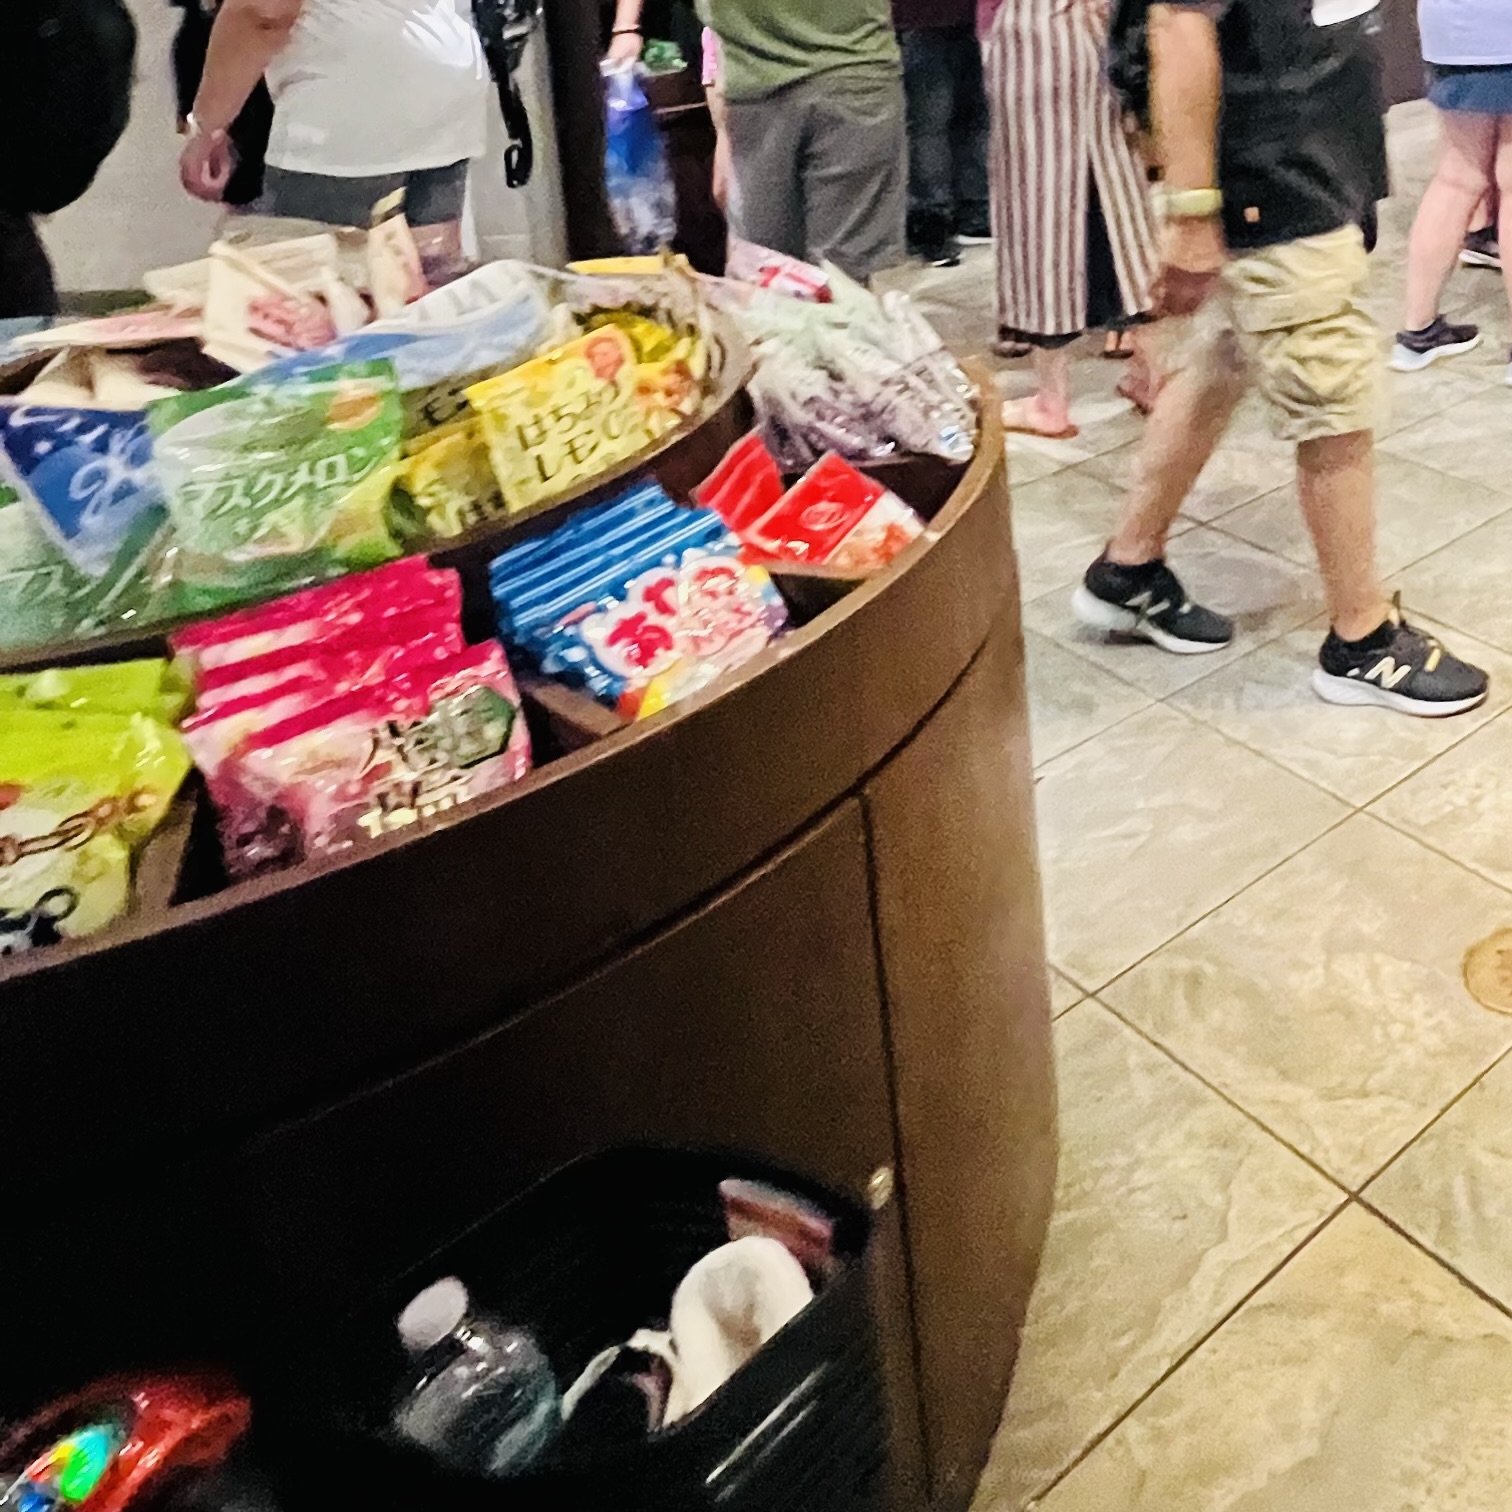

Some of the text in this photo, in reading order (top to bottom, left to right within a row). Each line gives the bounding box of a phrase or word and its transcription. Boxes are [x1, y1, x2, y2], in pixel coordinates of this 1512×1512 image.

[180, 445, 379, 522] マスクメロン
